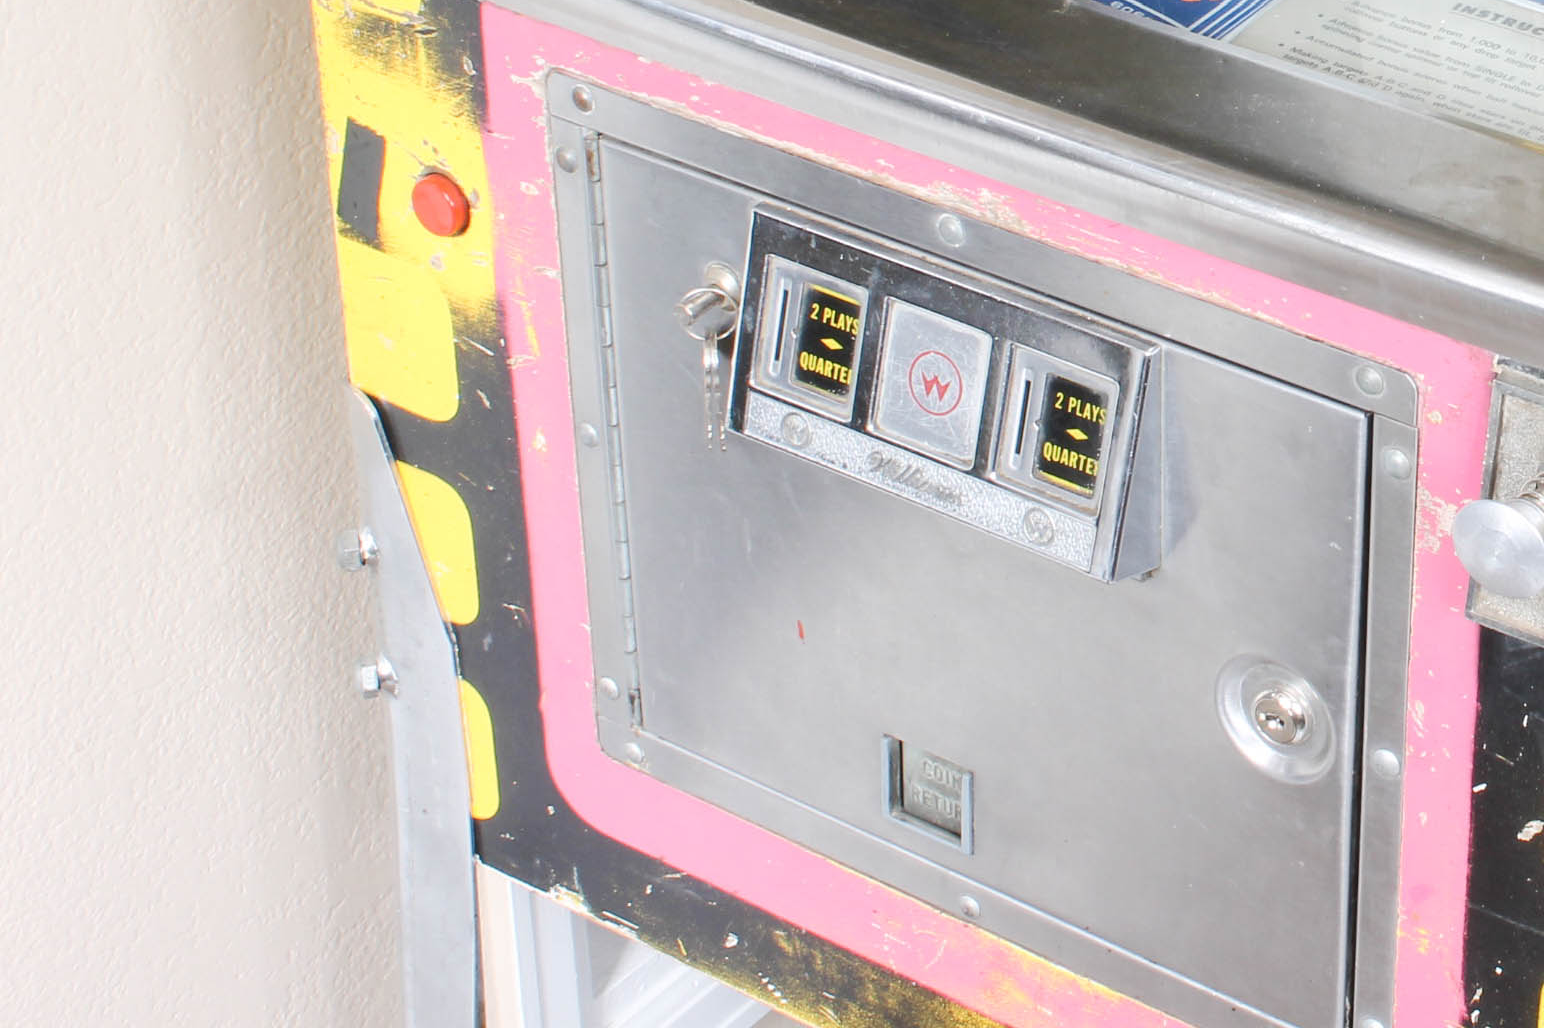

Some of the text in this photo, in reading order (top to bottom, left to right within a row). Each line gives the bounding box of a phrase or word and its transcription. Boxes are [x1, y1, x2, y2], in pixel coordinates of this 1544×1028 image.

[810, 302, 860, 336] 2 PLAYS
[1054, 392, 1108, 426] 2 PLAYS
